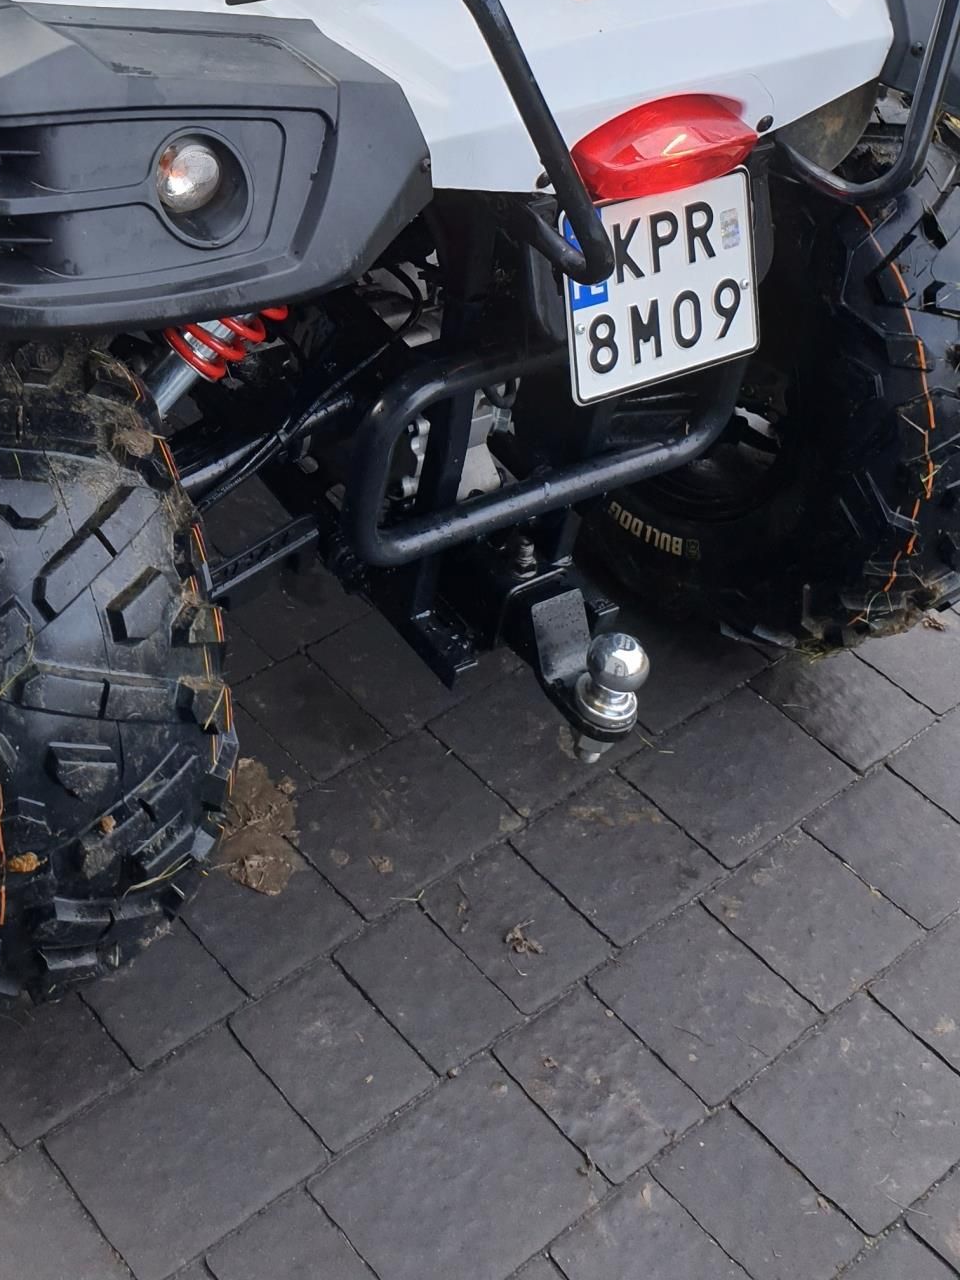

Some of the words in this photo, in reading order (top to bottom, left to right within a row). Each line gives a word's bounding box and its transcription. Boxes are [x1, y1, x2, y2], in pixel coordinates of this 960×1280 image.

[612, 201, 717, 284] KPR
[589, 277, 741, 374] 8M09
[607, 501, 683, 556] BULLDOG
